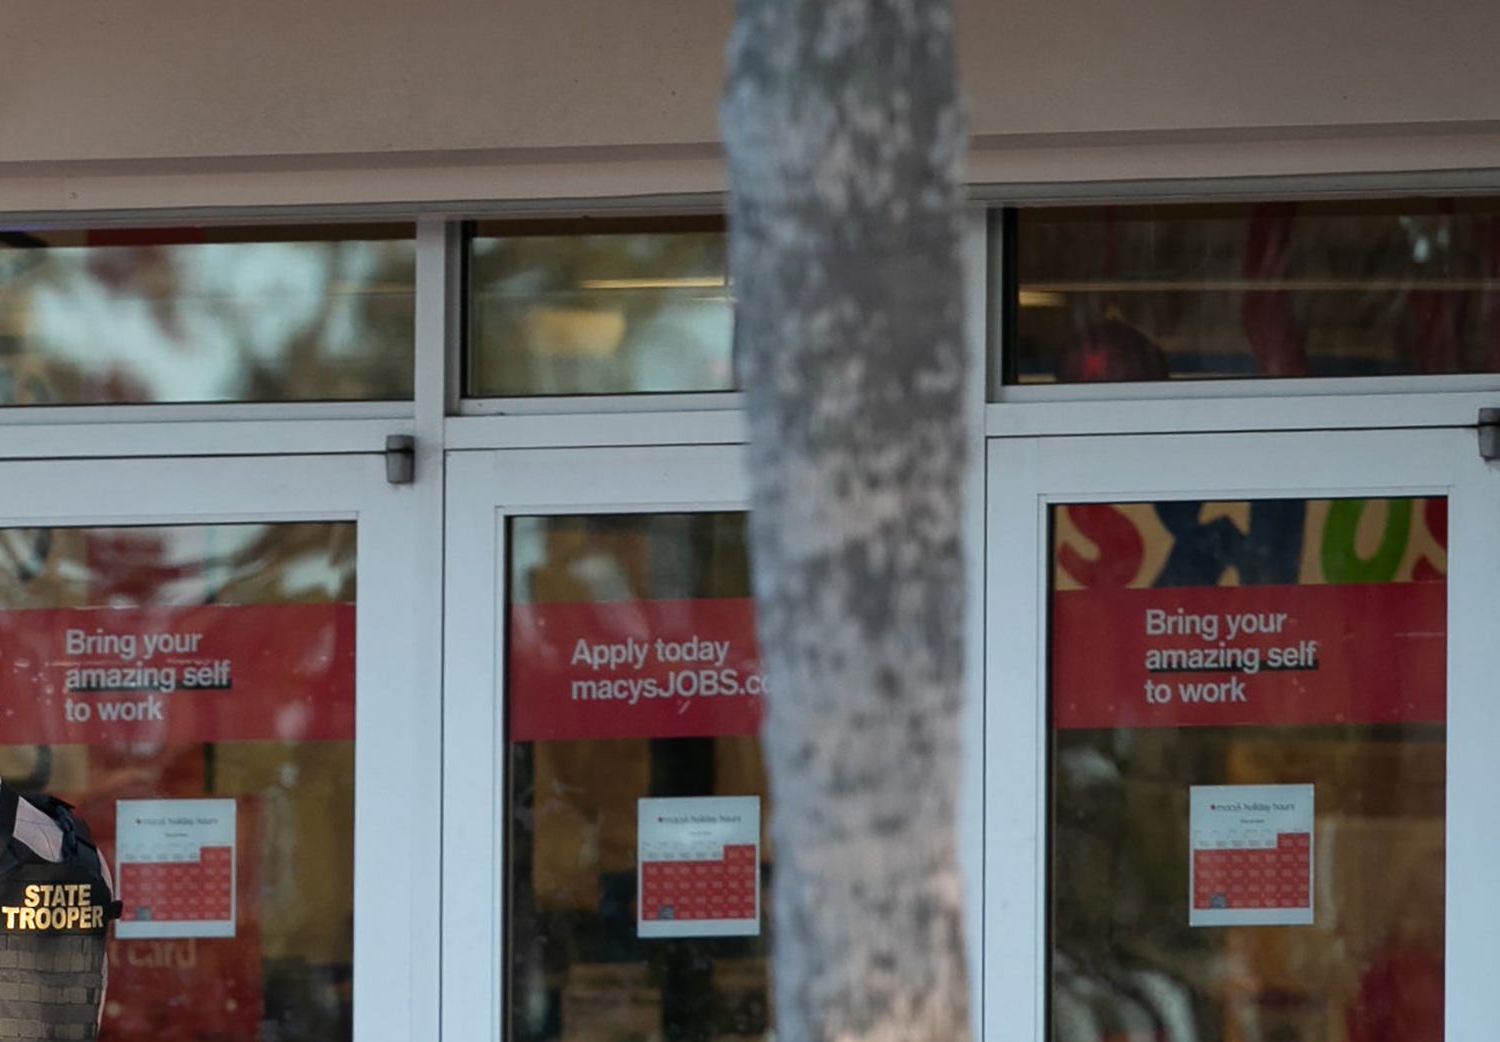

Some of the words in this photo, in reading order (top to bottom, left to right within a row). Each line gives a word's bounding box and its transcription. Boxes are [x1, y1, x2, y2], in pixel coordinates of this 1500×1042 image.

[1146, 608, 1218, 641] Bring
[1226, 613, 1287, 640] your
[66, 628, 136, 659] Bring
[143, 632, 202, 658] your
[571, 637, 648, 670] Apply
[655, 636, 729, 666] today
[1145, 641, 1260, 674] amazing
[1267, 640, 1317, 667] self
[65, 661, 175, 692] amazing
[183, 660, 231, 686] self
[1144, 678, 1172, 703] to
[1178, 676, 1247, 702] work
[65, 697, 91, 722] to
[97, 695, 164, 720] work
[24, 884, 92, 907] STATE
[2, 905, 104, 930] TROOPER
